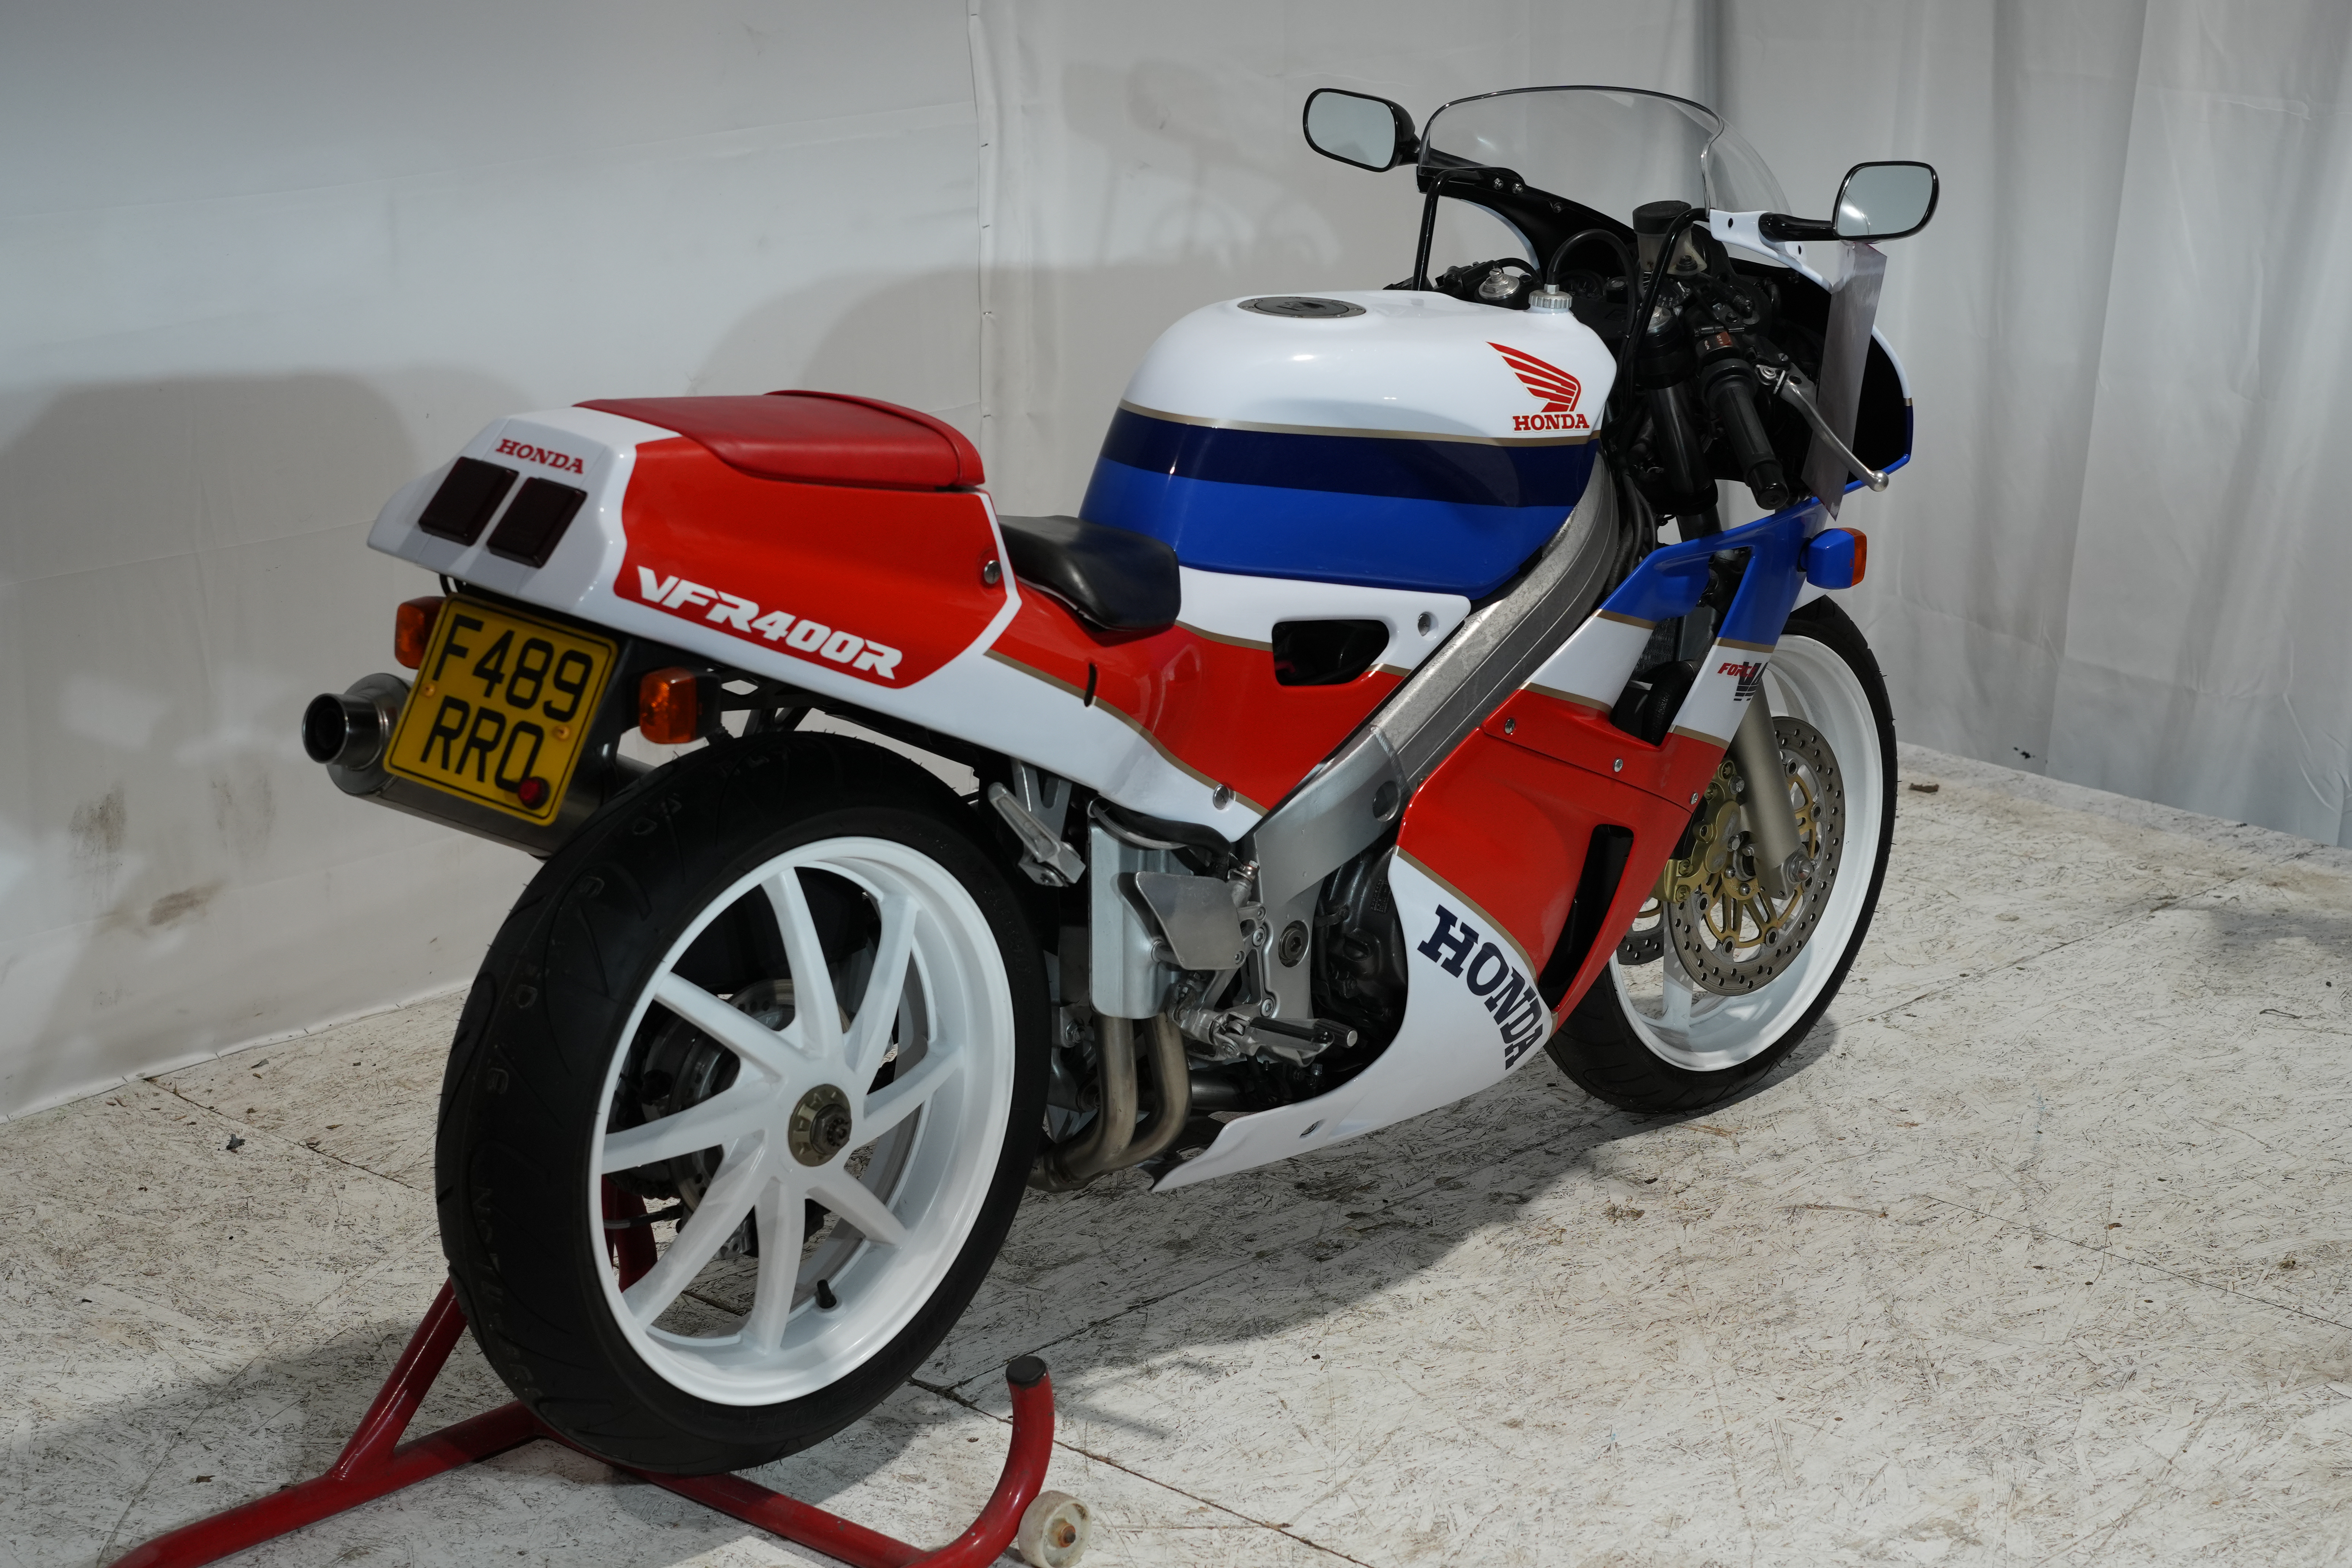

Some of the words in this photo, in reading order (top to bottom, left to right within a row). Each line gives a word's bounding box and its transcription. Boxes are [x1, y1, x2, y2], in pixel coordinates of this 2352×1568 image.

[495, 439, 584, 475] HONDA
[1514, 414, 1589, 431] HONDA
[433, 614, 593, 722] F489
[638, 566, 903, 680] VFR400R
[1717, 663, 1757, 677] FORCE
[420, 695, 544, 794] RRO
[1417, 904, 1543, 1070] HONDA
